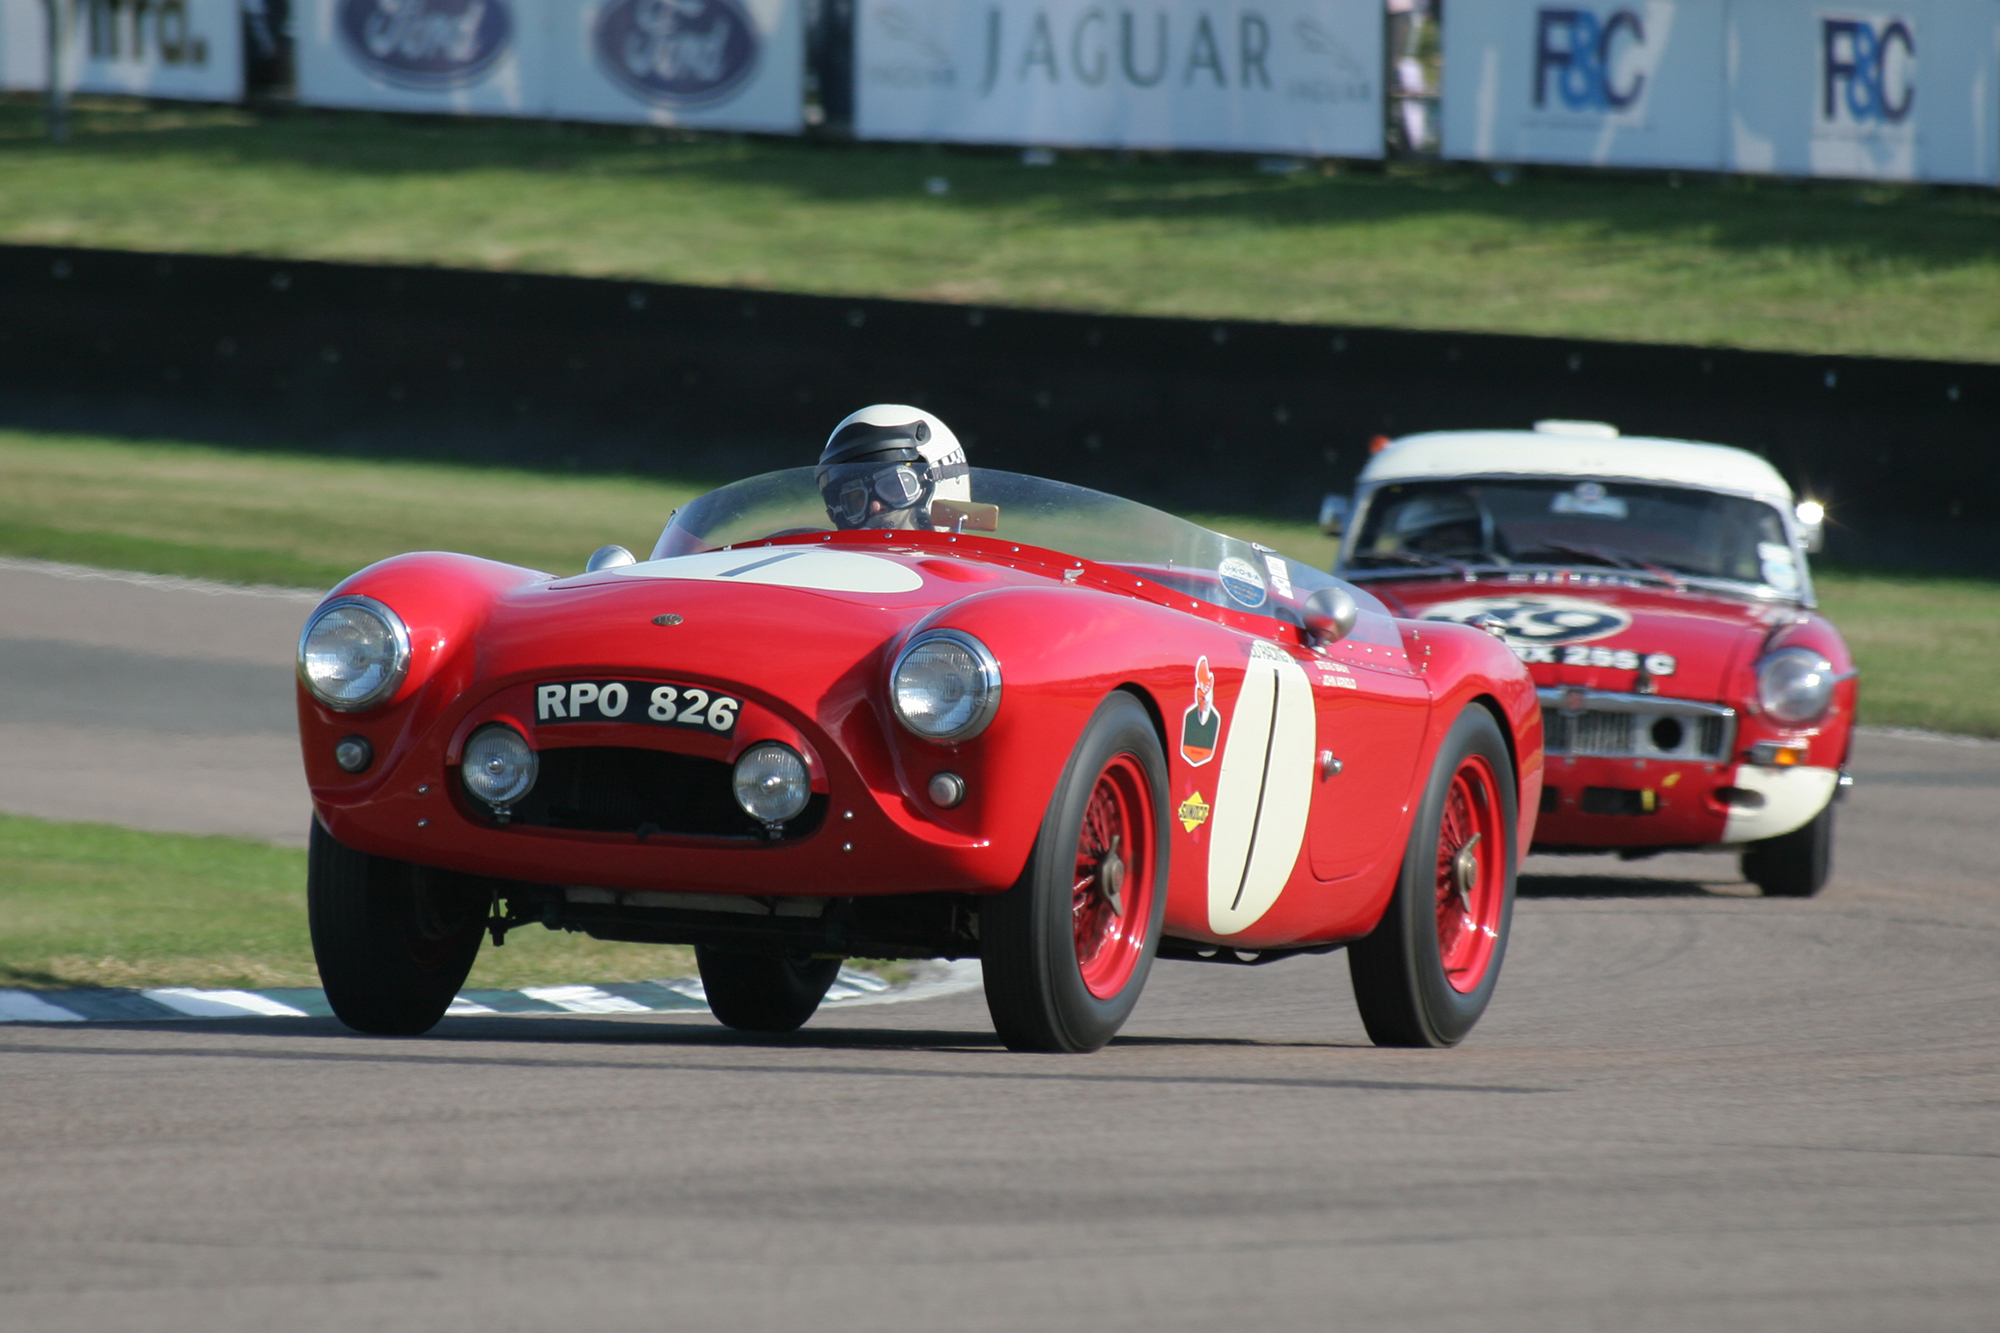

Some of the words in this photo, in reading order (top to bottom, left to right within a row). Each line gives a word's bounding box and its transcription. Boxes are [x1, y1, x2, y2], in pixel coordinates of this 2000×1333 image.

[624, 0, 732, 80] Ford
[980, 8, 1272, 95] JAGUAR
[1534, 9, 1646, 112] F&C
[1823, 17, 1917, 122] F&C
[538, 682, 629, 720] RPO
[648, 686, 738, 731] 826
[1179, 803, 1208, 821] SUNOCO
[1230, 668, 1280, 911] 1
